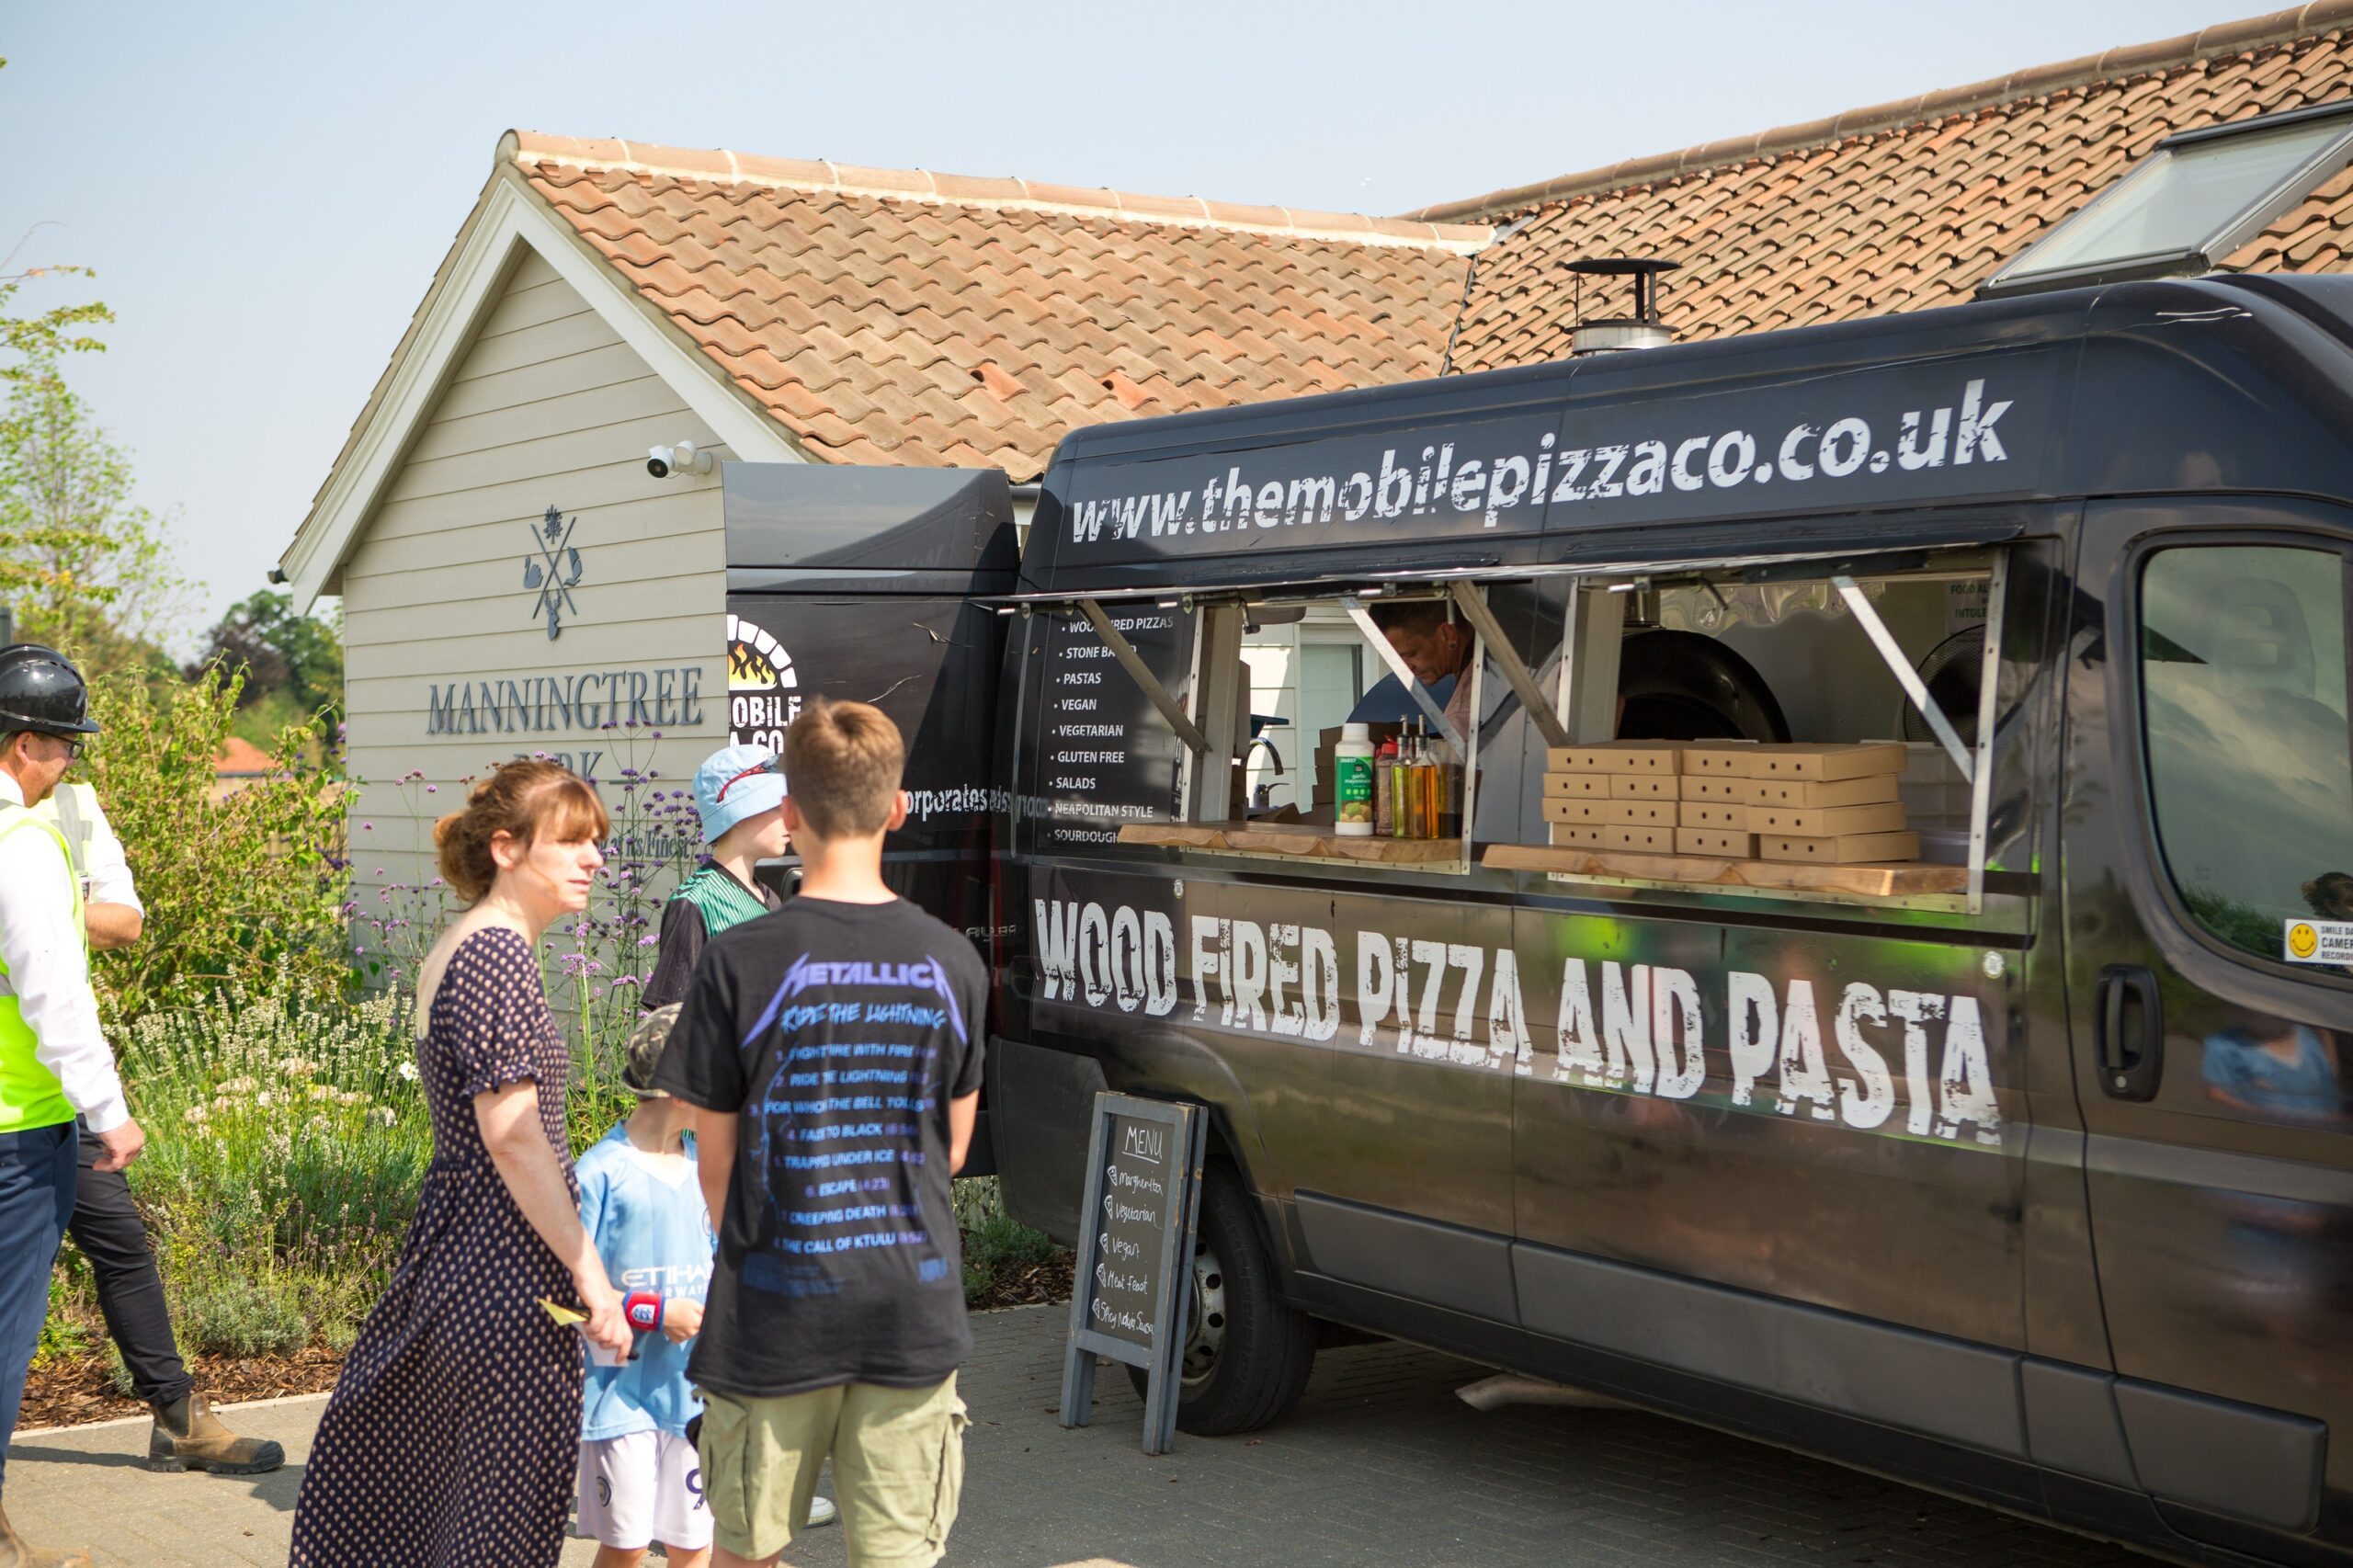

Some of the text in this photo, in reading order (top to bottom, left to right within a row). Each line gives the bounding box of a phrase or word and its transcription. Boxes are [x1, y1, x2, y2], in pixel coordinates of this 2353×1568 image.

[1073, 379, 2014, 543] www.themobilepizzaco.co.uk
[1136, 616, 1174, 630] PIZZAS
[1066, 646, 1100, 659] STONE
[1063, 672, 1102, 685] PASTAS
[426, 666, 704, 735] MANNINGTREE
[1062, 699, 1097, 710] VEGAN
[1059, 724, 1124, 736] VEGETARIAN
[1057, 751, 1125, 764] GLUTEN FREE
[1055, 777, 1097, 790] SALADS
[1055, 803, 1154, 818] NEAPOLITAN STYLE
[2321, 926, 2342, 935] SMILE
[739, 951, 968, 1049] METALLICA
[779, 1001, 948, 1034] RIDE THE LIGHTNING
[1034, 897, 2003, 1146] WOOD FIRED PIZZA AND PASTA
[790, 1073, 820, 1086] RIDE
[839, 1068, 908, 1084] LIGHTNING
[764, 1100, 791, 1115] FOR
[853, 1096, 883, 1110] BELL
[841, 1122, 883, 1138] BLACK
[1124, 1125, 1163, 1160] MENU
[874, 1149, 895, 1164] ICE
[845, 1205, 887, 1221] DEATH
[803, 1238, 835, 1255] CALL
[835, 1236, 853, 1251] OF
[854, 1232, 897, 1249] KTULU
[1112, 1236, 1141, 1261] Vegan
[686, 1467, 707, 1510] 9
